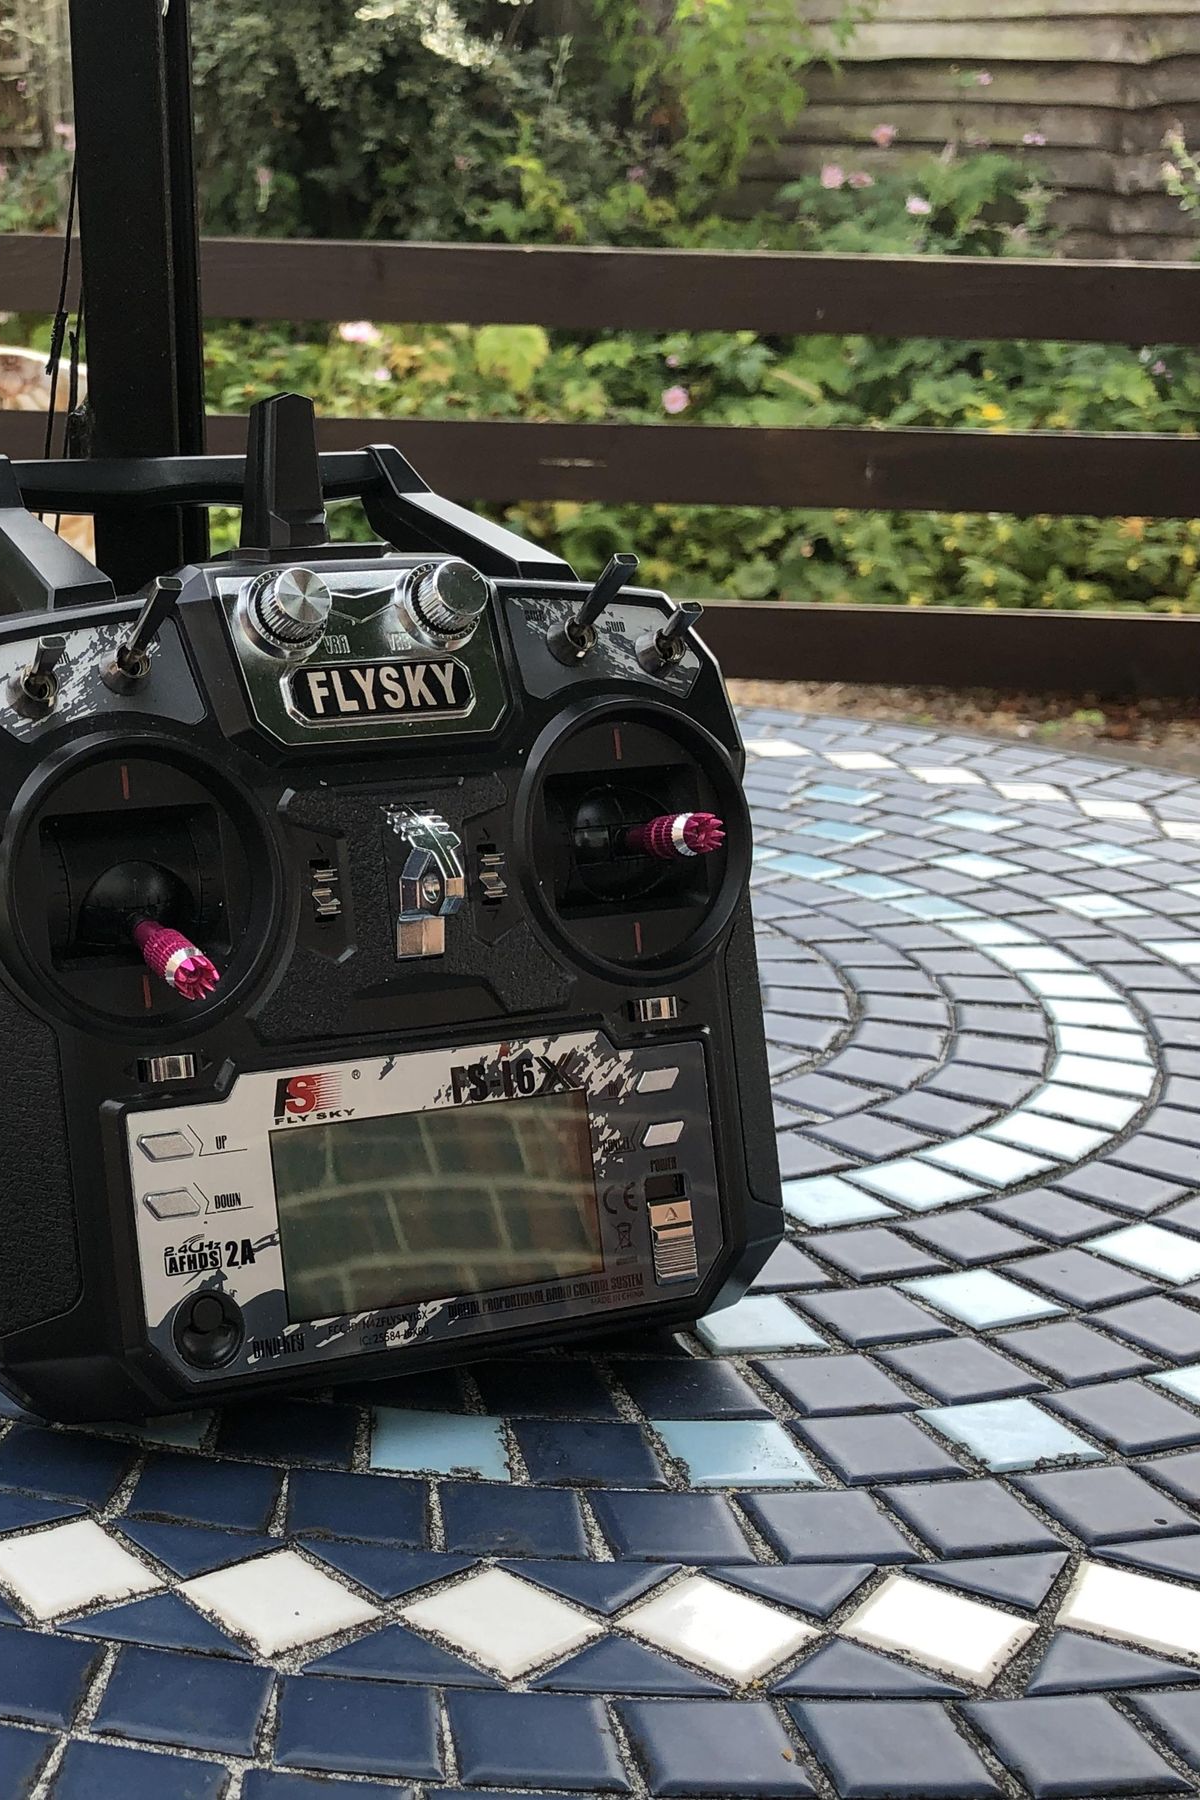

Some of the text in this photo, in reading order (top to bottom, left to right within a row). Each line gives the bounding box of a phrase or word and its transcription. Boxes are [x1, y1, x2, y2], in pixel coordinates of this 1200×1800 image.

[322, 634, 351, 654] VRA
[306, 662, 457, 714] FLYSKY
[215, 1135, 228, 1150] UP
[650, 1156, 677, 1173] POWER
[214, 1192, 242, 1209] DOWN
[168, 1238, 256, 1274] AFHDS 2A
[483, 1290, 545, 1313] PROPORTIONAL
[573, 1279, 609, 1297] CONTROL
[610, 1273, 644, 1290] SYSTEM
